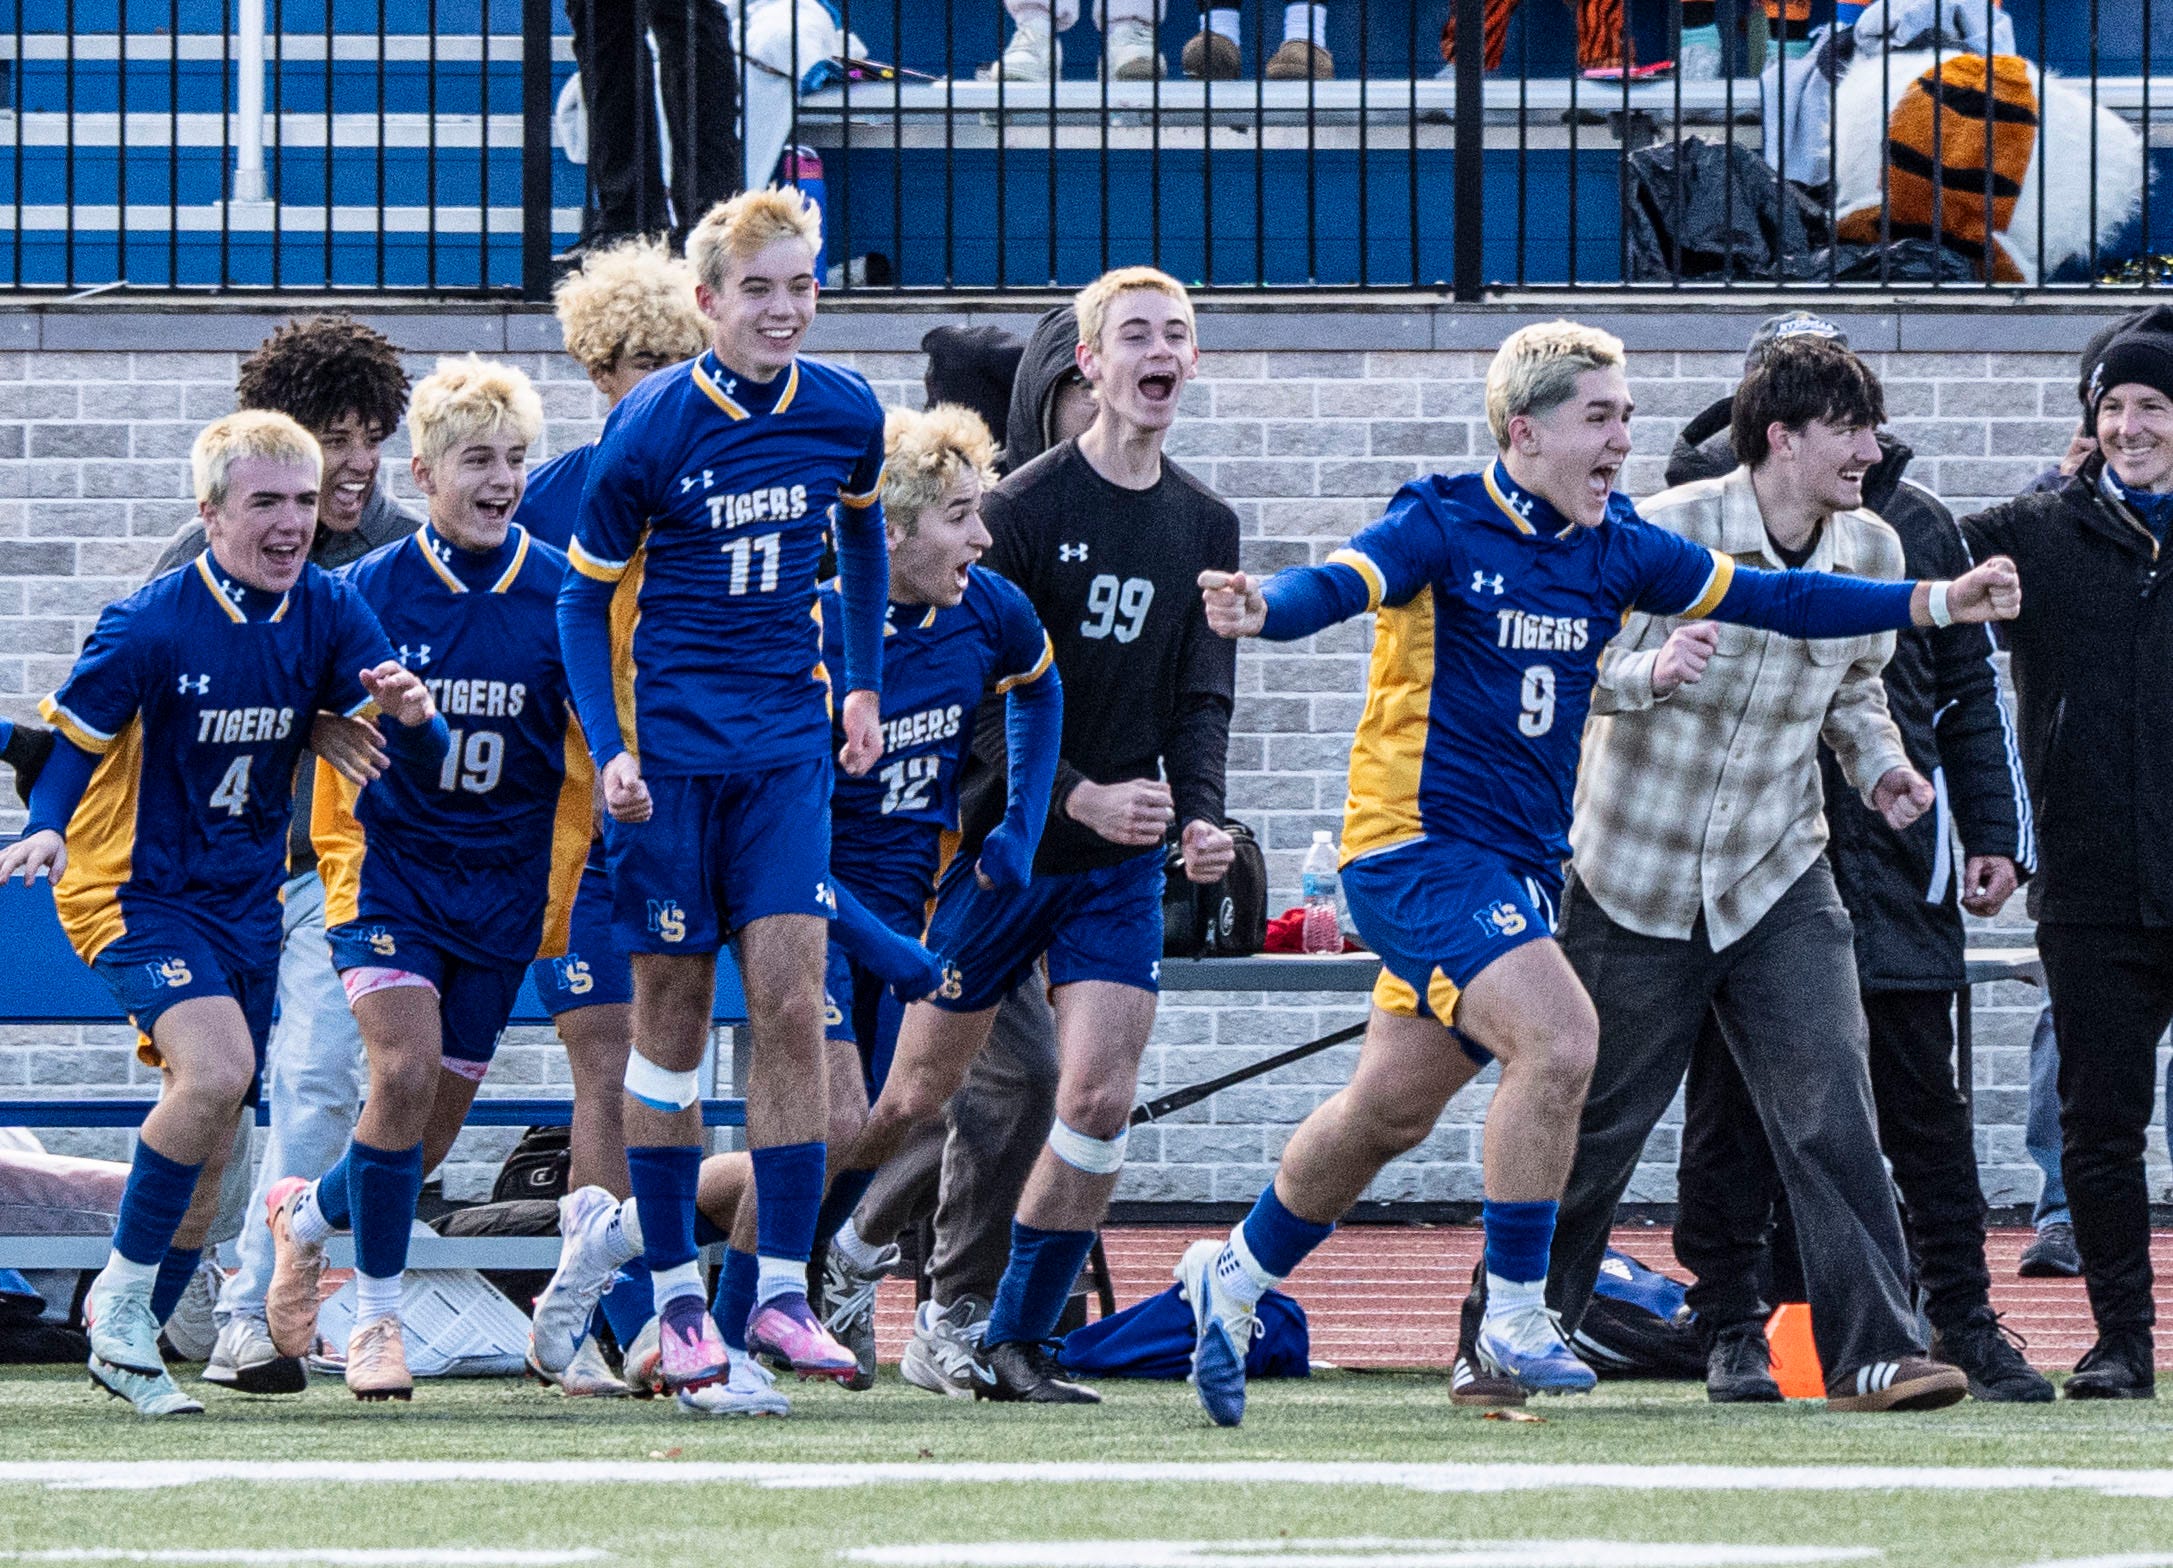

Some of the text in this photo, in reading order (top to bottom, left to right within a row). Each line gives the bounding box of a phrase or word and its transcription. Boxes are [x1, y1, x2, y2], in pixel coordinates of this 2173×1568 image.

[705, 484, 808, 530] TIGERS
[720, 531, 782, 596] 11
[1079, 574, 1155, 644] 99
[1496, 607, 1589, 652] TIGERS
[197, 706, 295, 744] TIGERS
[424, 678, 527, 718] TIGERS
[1517, 664, 1556, 737] 9
[208, 754, 254, 817] 4
[439, 728, 505, 794] 19
[879, 754, 941, 815] 12
